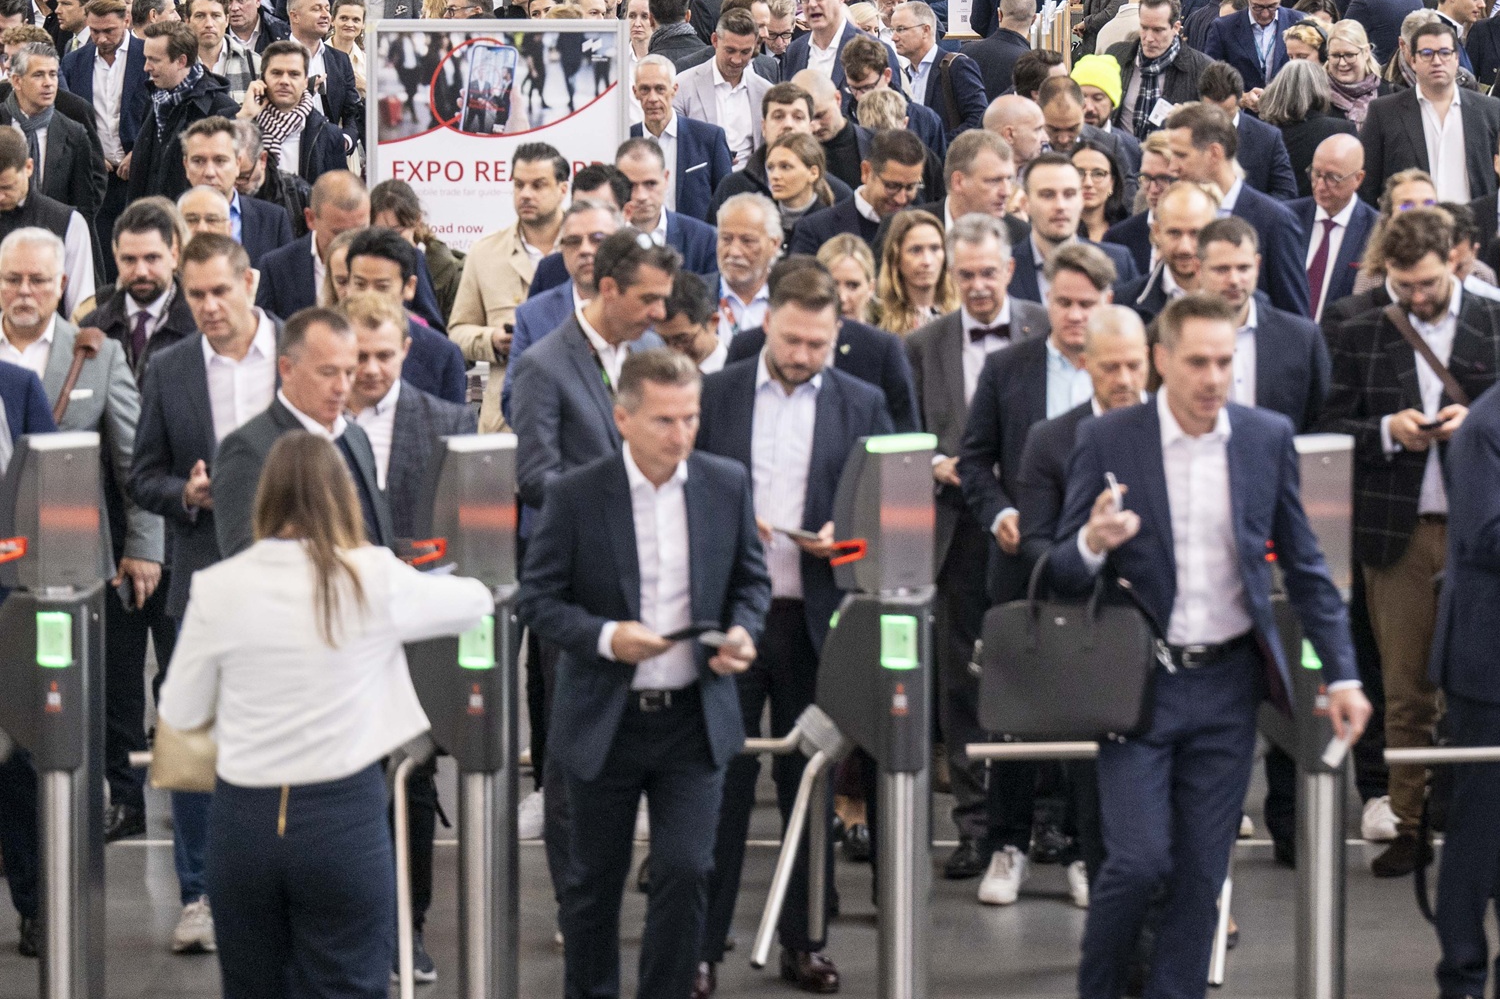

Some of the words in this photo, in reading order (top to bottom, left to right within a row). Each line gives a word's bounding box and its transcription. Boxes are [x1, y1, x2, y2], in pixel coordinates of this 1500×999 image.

[392, 160, 464, 182] EXPO
[439, 188, 461, 196] trade
[462, 187, 476, 196] fair
[457, 225, 484, 234] now
